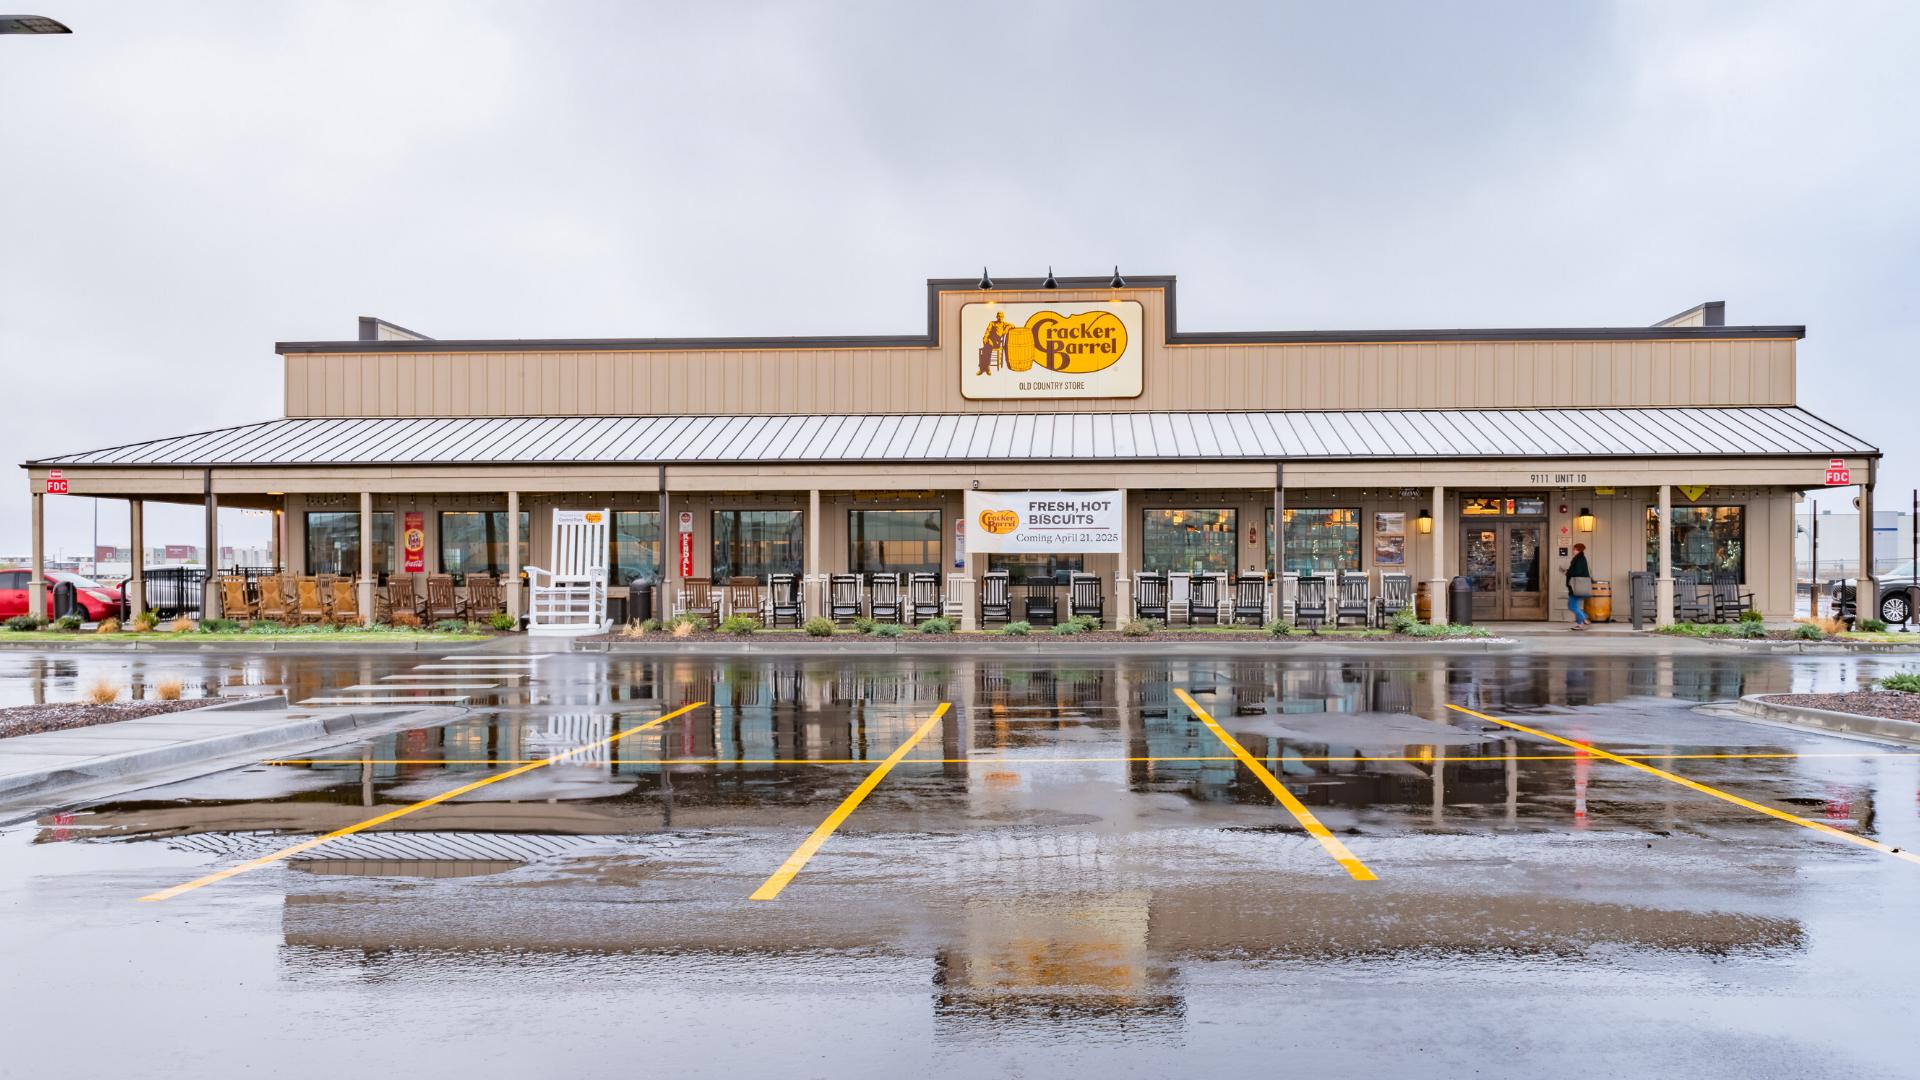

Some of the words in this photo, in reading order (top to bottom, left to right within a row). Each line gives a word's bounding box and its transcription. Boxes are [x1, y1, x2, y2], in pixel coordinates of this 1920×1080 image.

[1032, 318, 1116, 353] Cracker
[1046, 338, 1117, 372] Barrel
[1019, 382, 1032, 391] OLD
[1033, 381, 1063, 390] COUNTRY
[1064, 381, 1085, 390] STORE
[1530, 474, 1548, 484] 9111
[1555, 474, 1574, 483] UNIT
[1577, 474, 1587, 483] 10
[1826, 472, 1848, 482] FDC
[47, 481, 67, 491] FDC
[1028, 502, 1079, 514] FRESH,
[1081, 501, 1111, 512] HOT
[982, 512, 1015, 527] Cracker
[1028, 514, 1094, 525] BISCUITS
[987, 520, 1016, 534] Barrel
[1016, 533, 1053, 544] Coming
[1055, 532, 1078, 544] April
[1096, 533, 1119, 542] 2025
